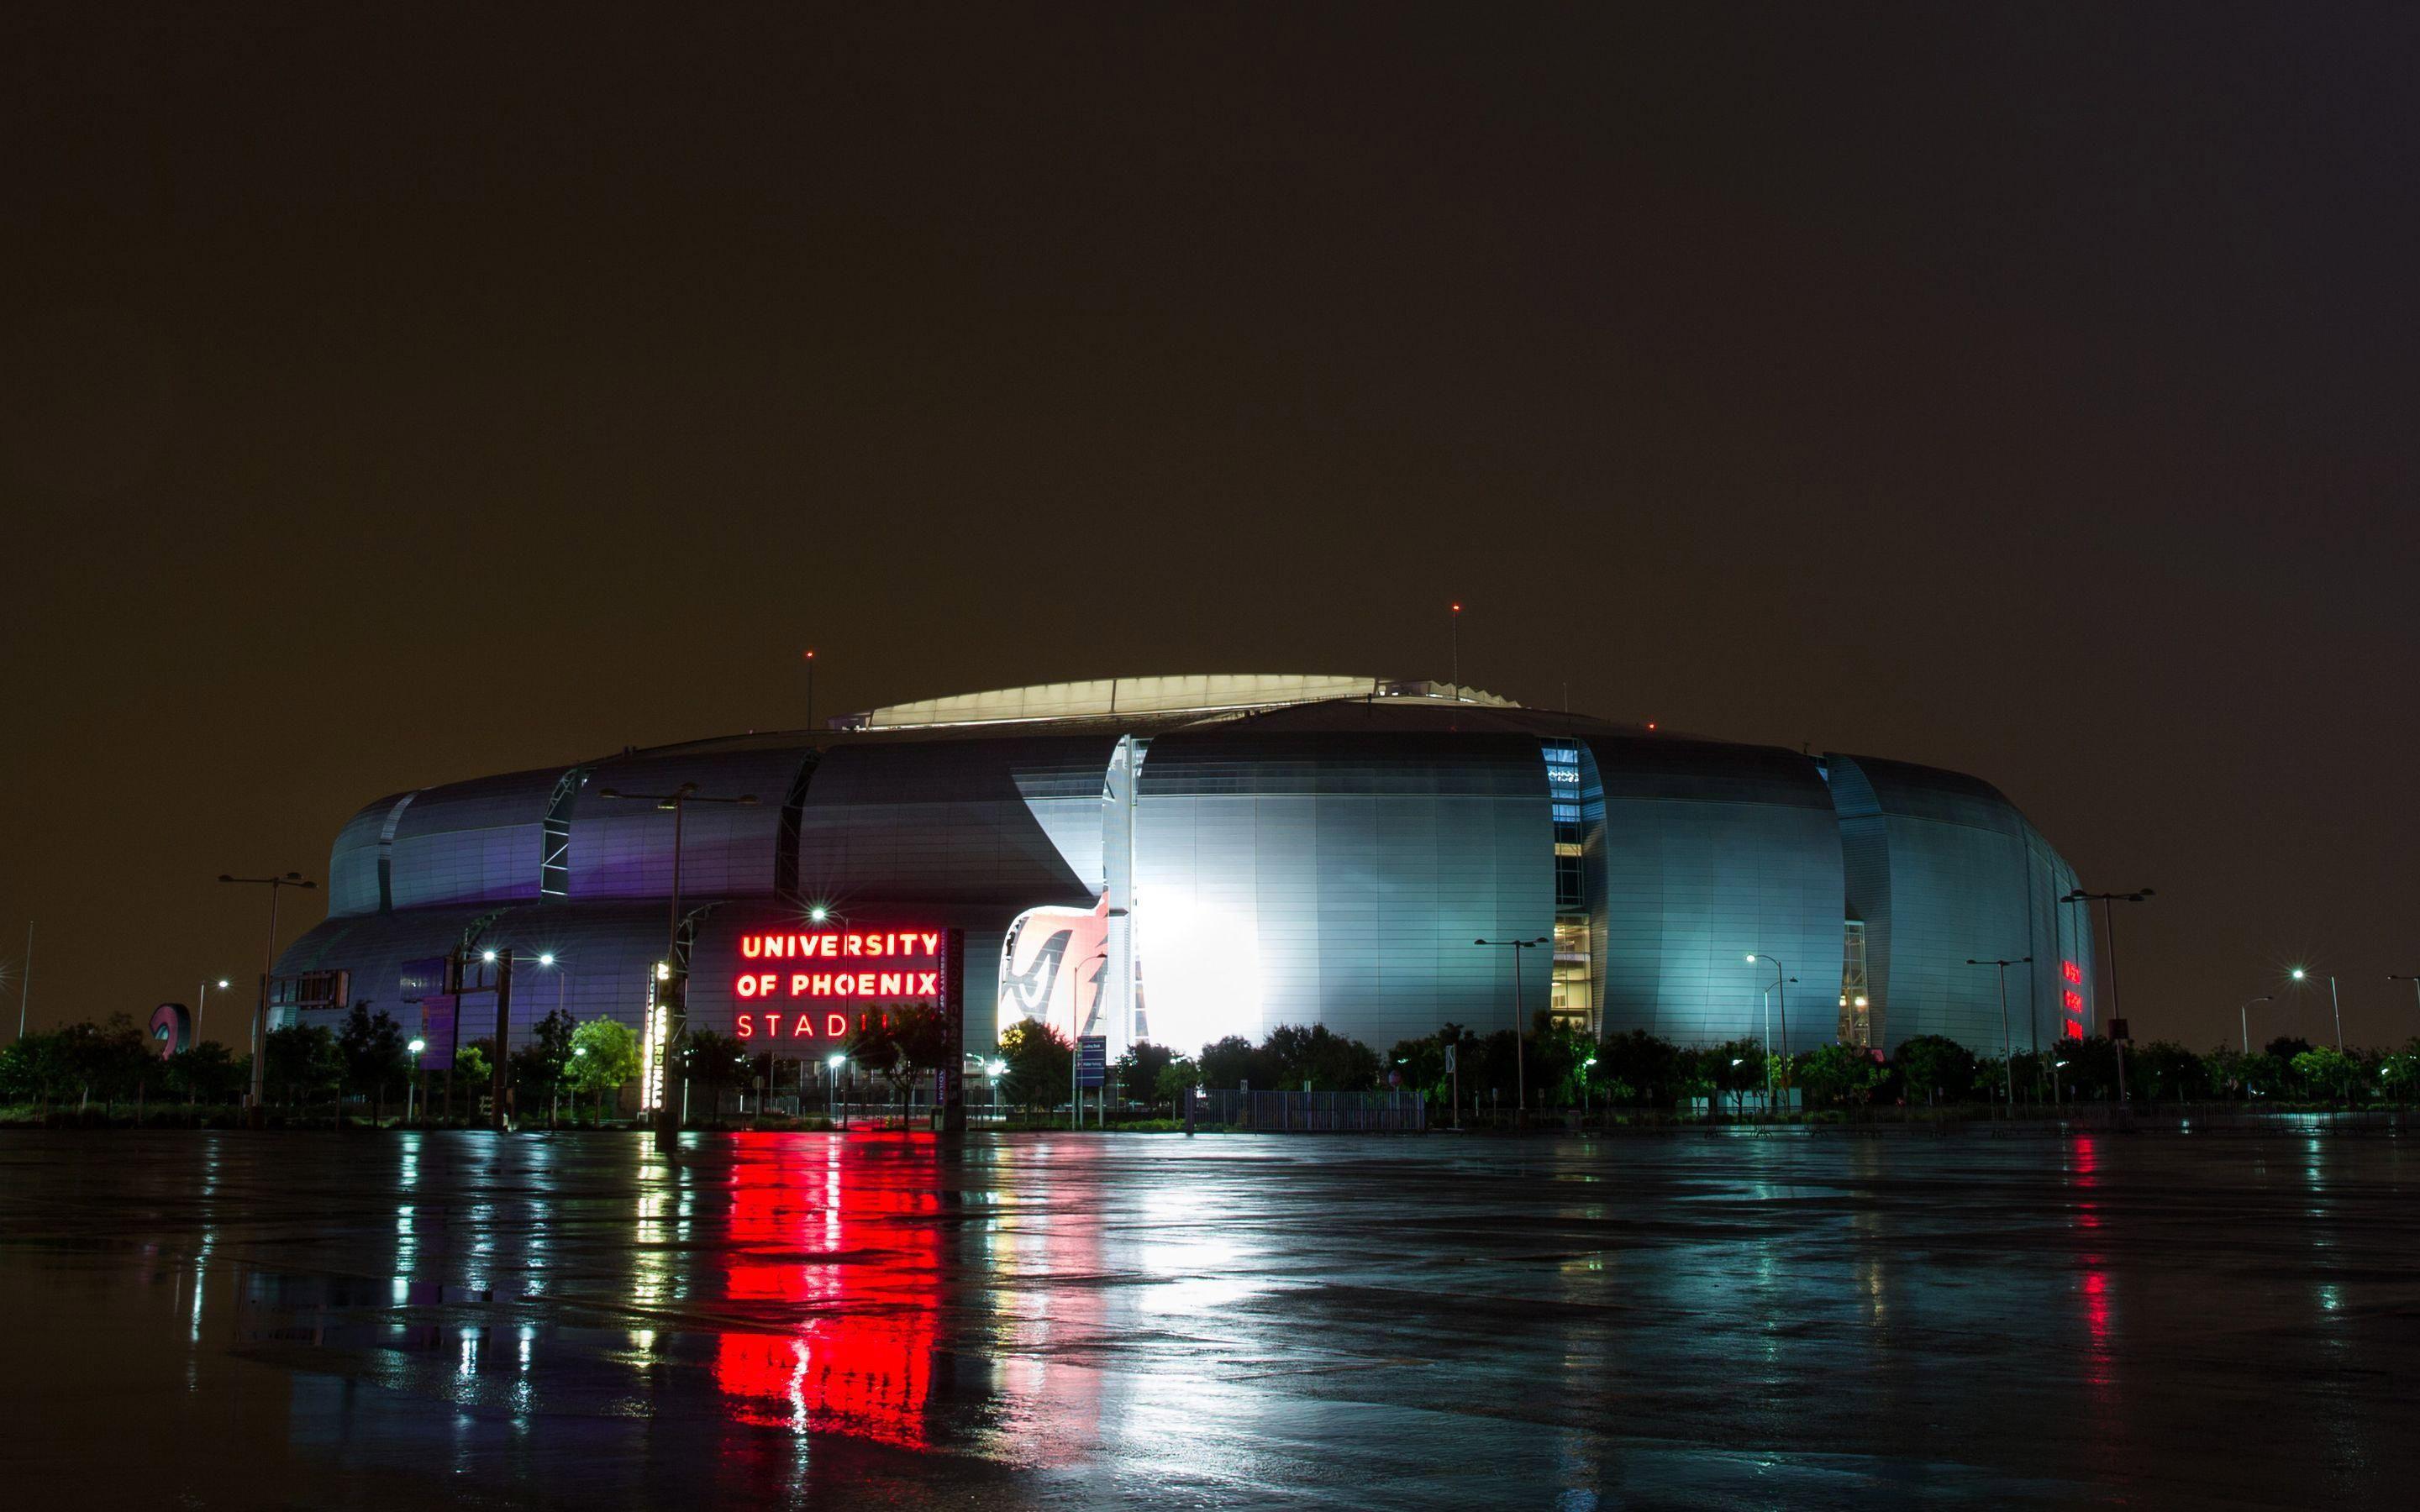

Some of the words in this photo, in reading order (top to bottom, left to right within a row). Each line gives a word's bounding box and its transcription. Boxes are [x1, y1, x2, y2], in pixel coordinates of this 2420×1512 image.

[742, 933, 938, 958] UNIVERSITY
[737, 974, 776, 996] OF
[792, 973, 937, 995] PHOENIX
[652, 1024, 666, 1108] CARDINALS
